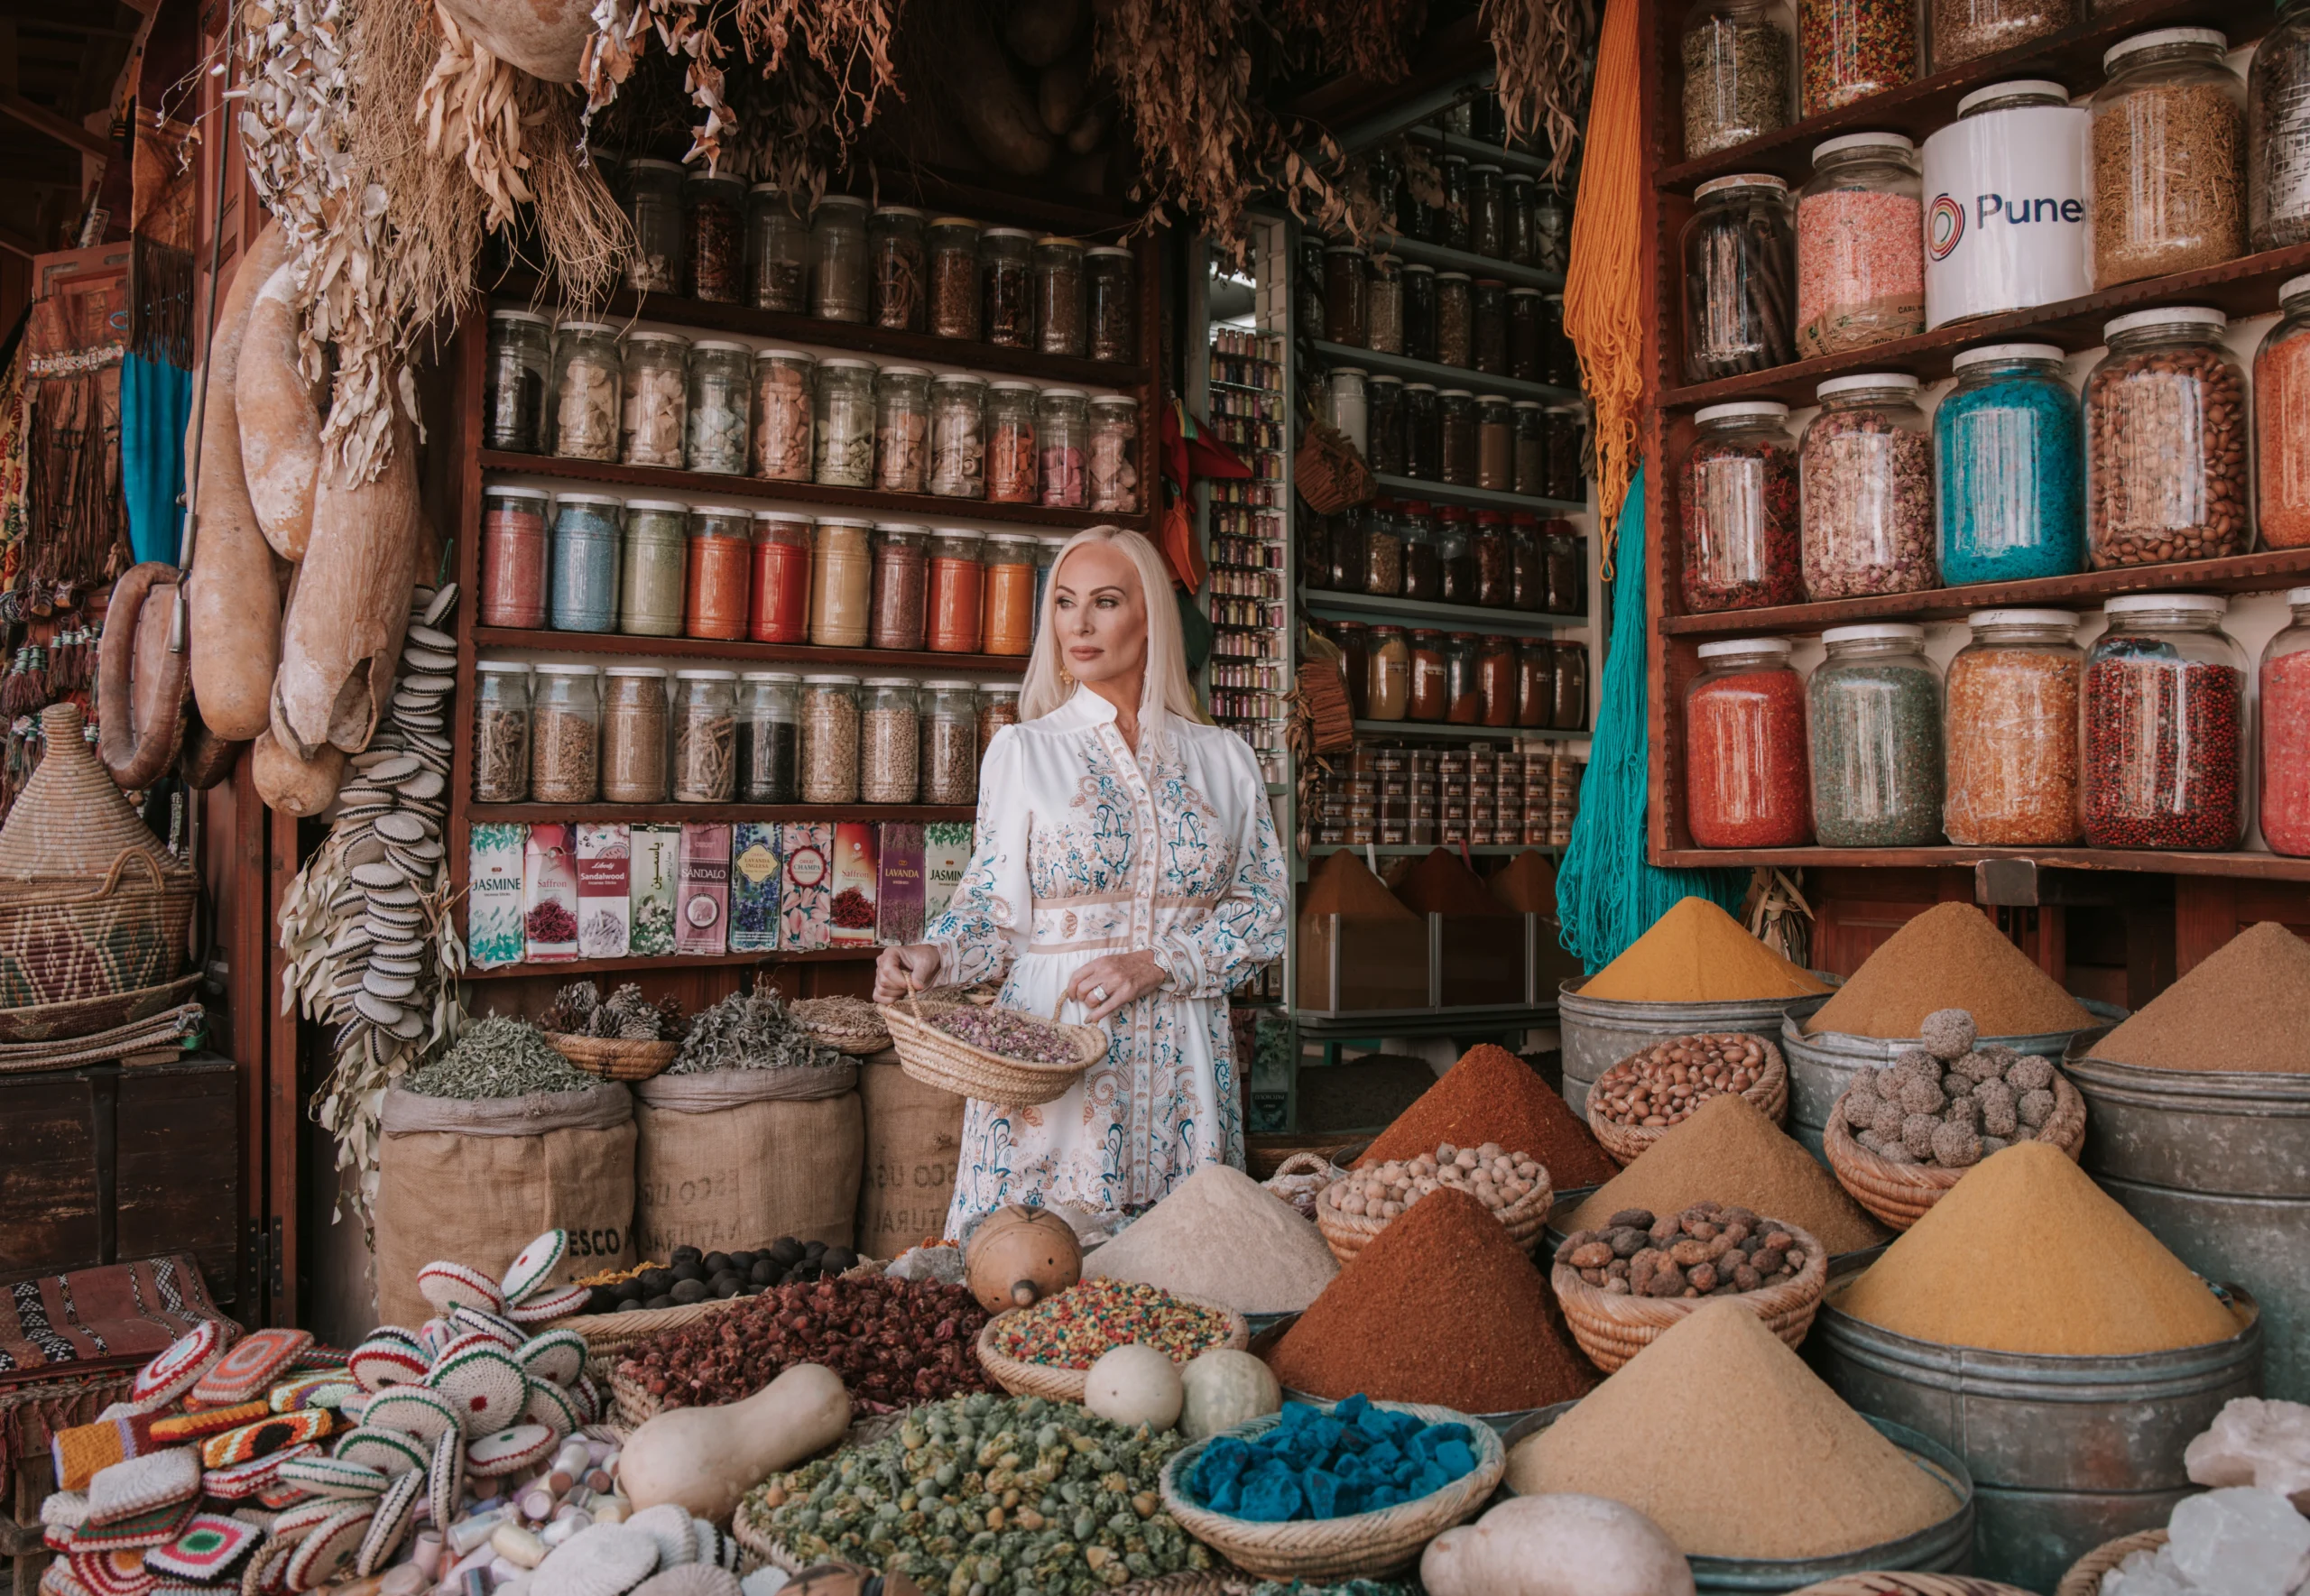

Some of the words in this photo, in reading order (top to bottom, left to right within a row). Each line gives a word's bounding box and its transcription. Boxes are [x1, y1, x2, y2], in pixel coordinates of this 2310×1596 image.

[1976, 193, 2084, 230] Pune
[1898, 306, 1916, 314] CARL
[681, 866, 726, 879] SÁNDALO
[841, 870, 869, 878] Saffron
[885, 868, 919, 878] LAVANDA
[473, 878, 521, 891] JASMINE
[538, 878, 567, 888] Saffron
[568, 1227, 620, 1257] ESCO
